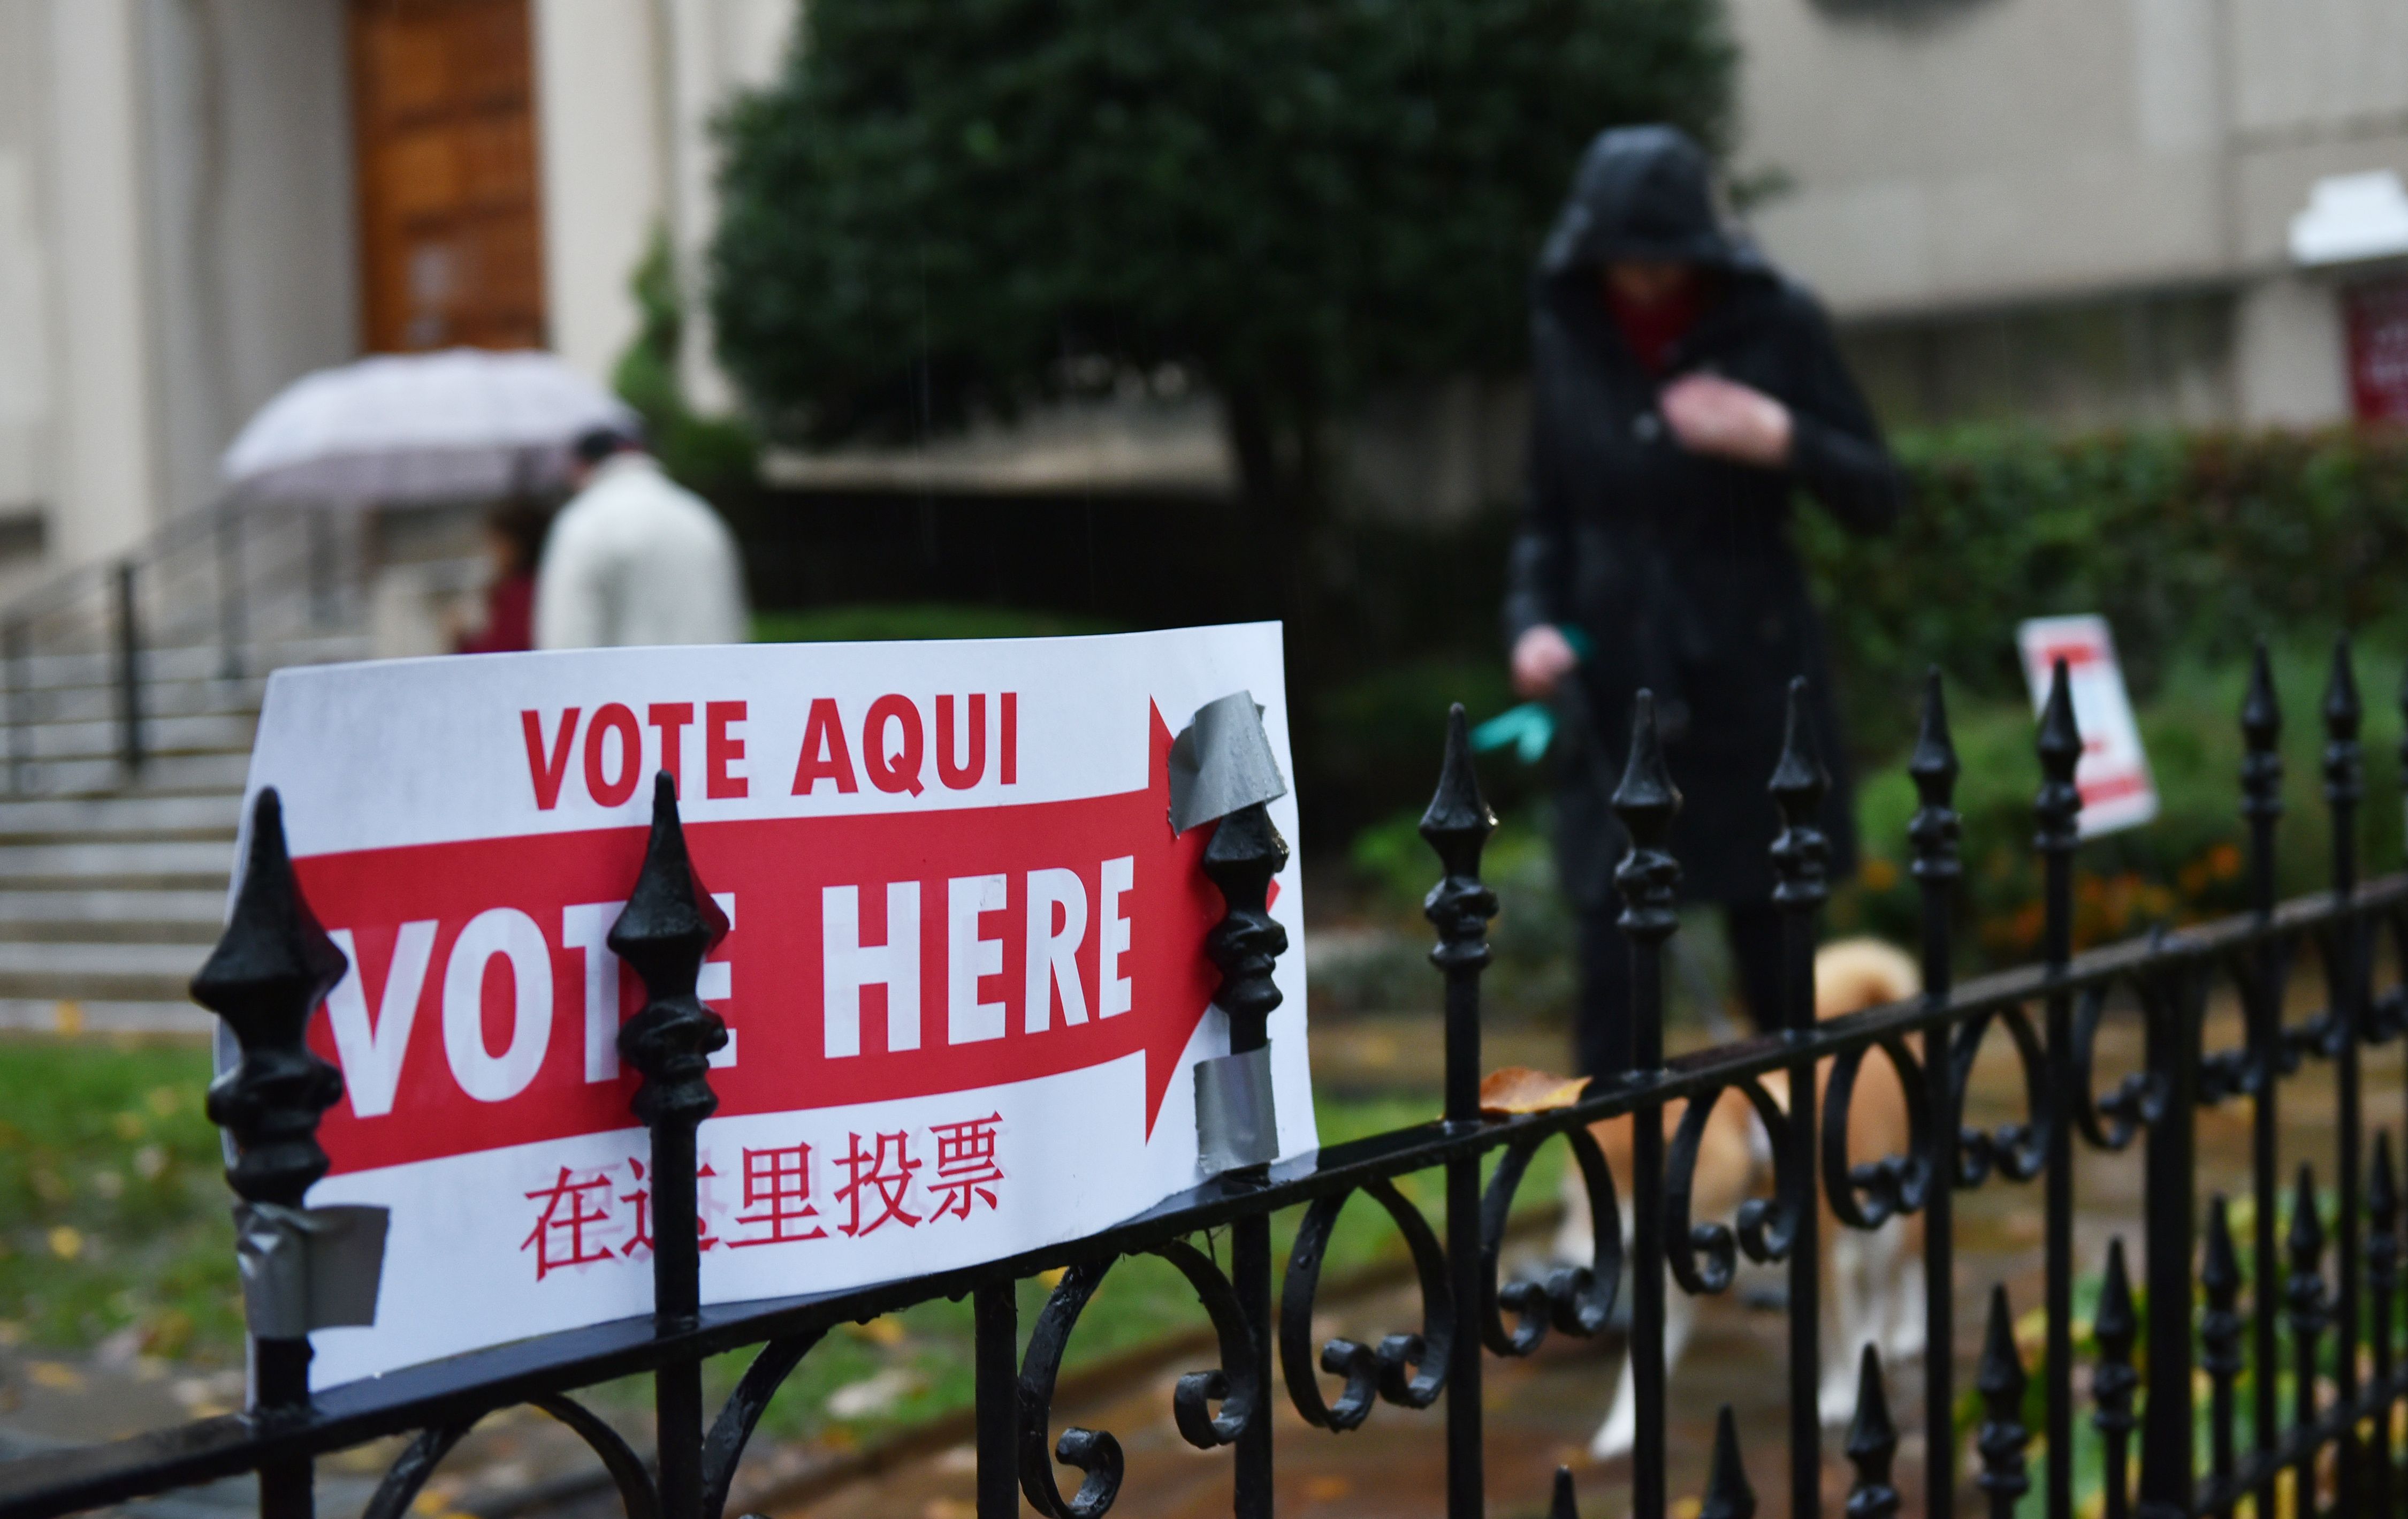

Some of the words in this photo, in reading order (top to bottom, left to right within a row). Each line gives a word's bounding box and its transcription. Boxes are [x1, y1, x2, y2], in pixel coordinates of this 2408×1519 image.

[521, 701, 748, 810] VOTE
[790, 692, 1018, 798] AQUI
[822, 855, 1134, 1059] HERE
